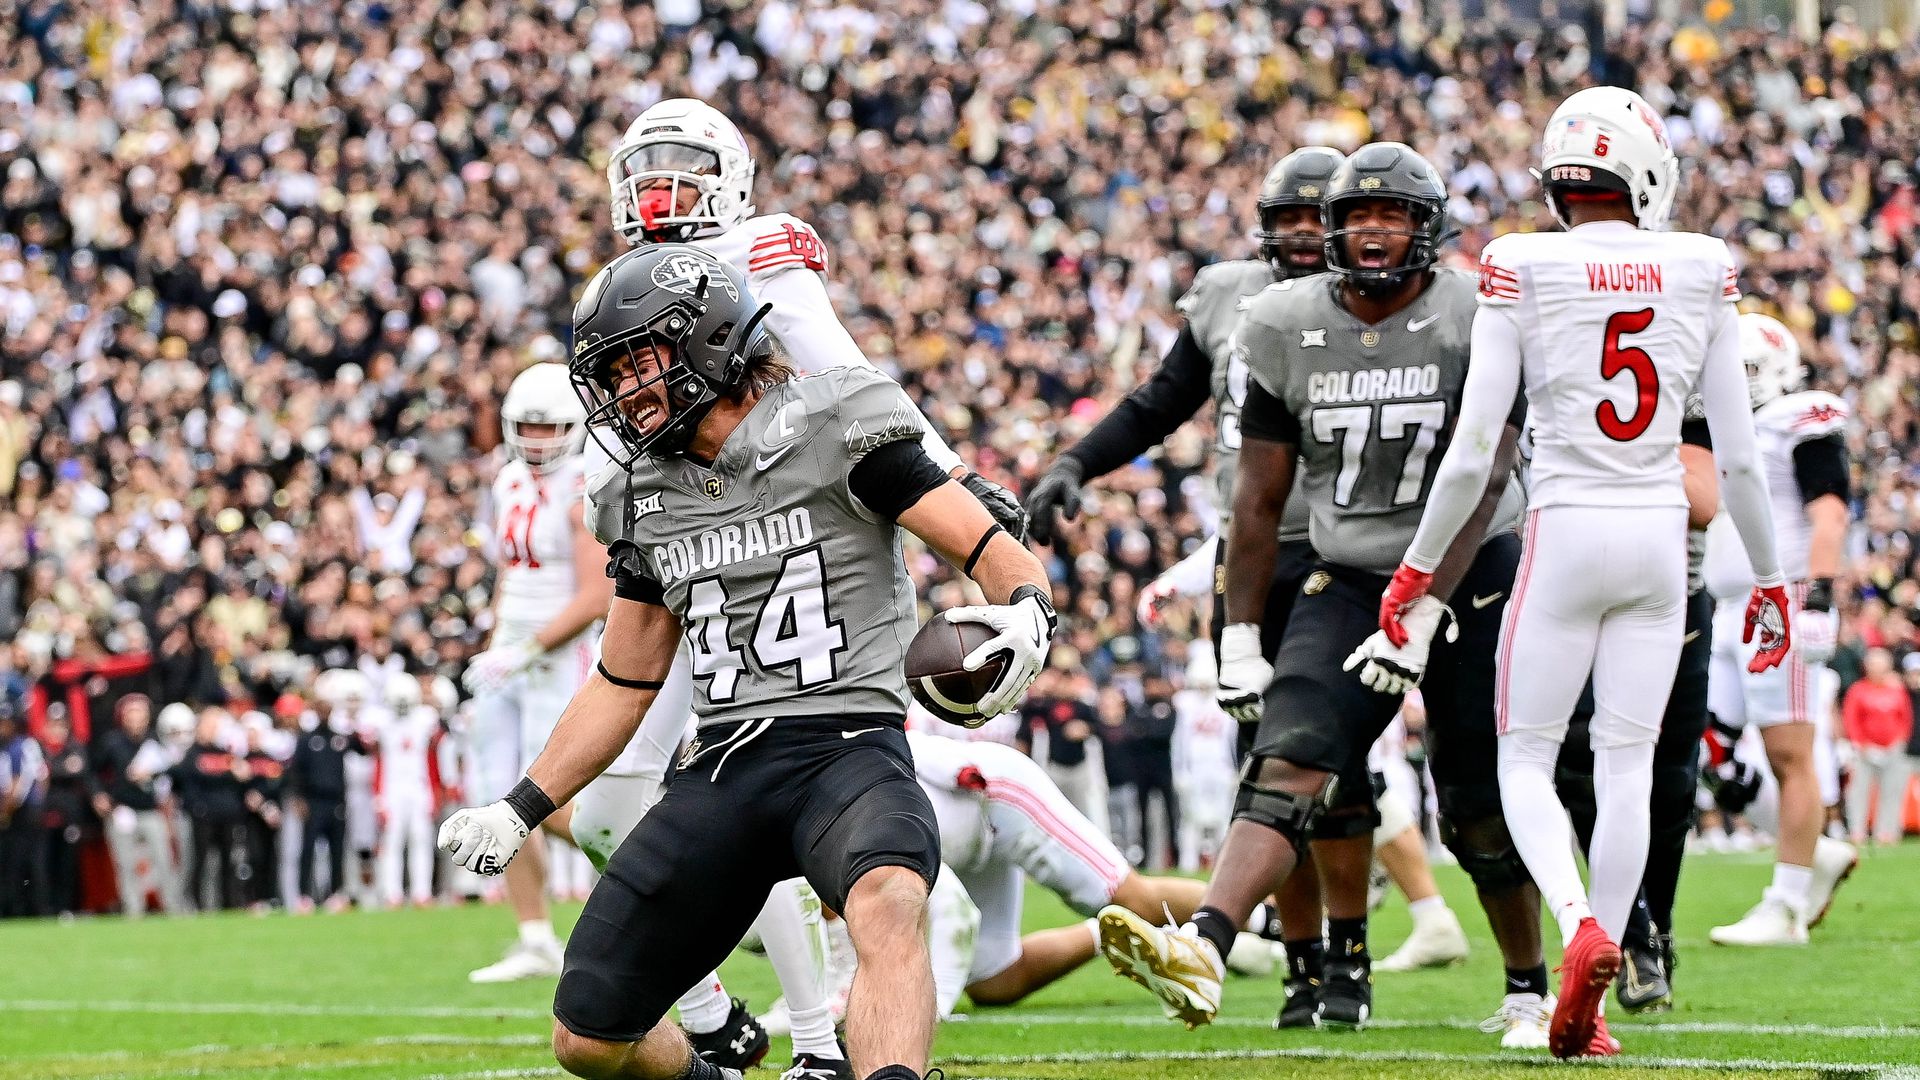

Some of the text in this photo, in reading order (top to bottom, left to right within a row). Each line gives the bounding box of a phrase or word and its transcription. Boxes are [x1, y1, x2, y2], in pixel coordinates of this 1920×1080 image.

[1595, 134, 1610, 157] 5
[1551, 166, 1591, 181] UTES
[1586, 263, 1661, 293] VAUGHN
[1308, 363, 1440, 403] COLORADO
[1596, 306, 1659, 442] 5
[1312, 401, 1446, 506] 77
[705, 477, 724, 500] CU
[653, 507, 814, 584] COLORADO
[685, 543, 849, 704] 44
